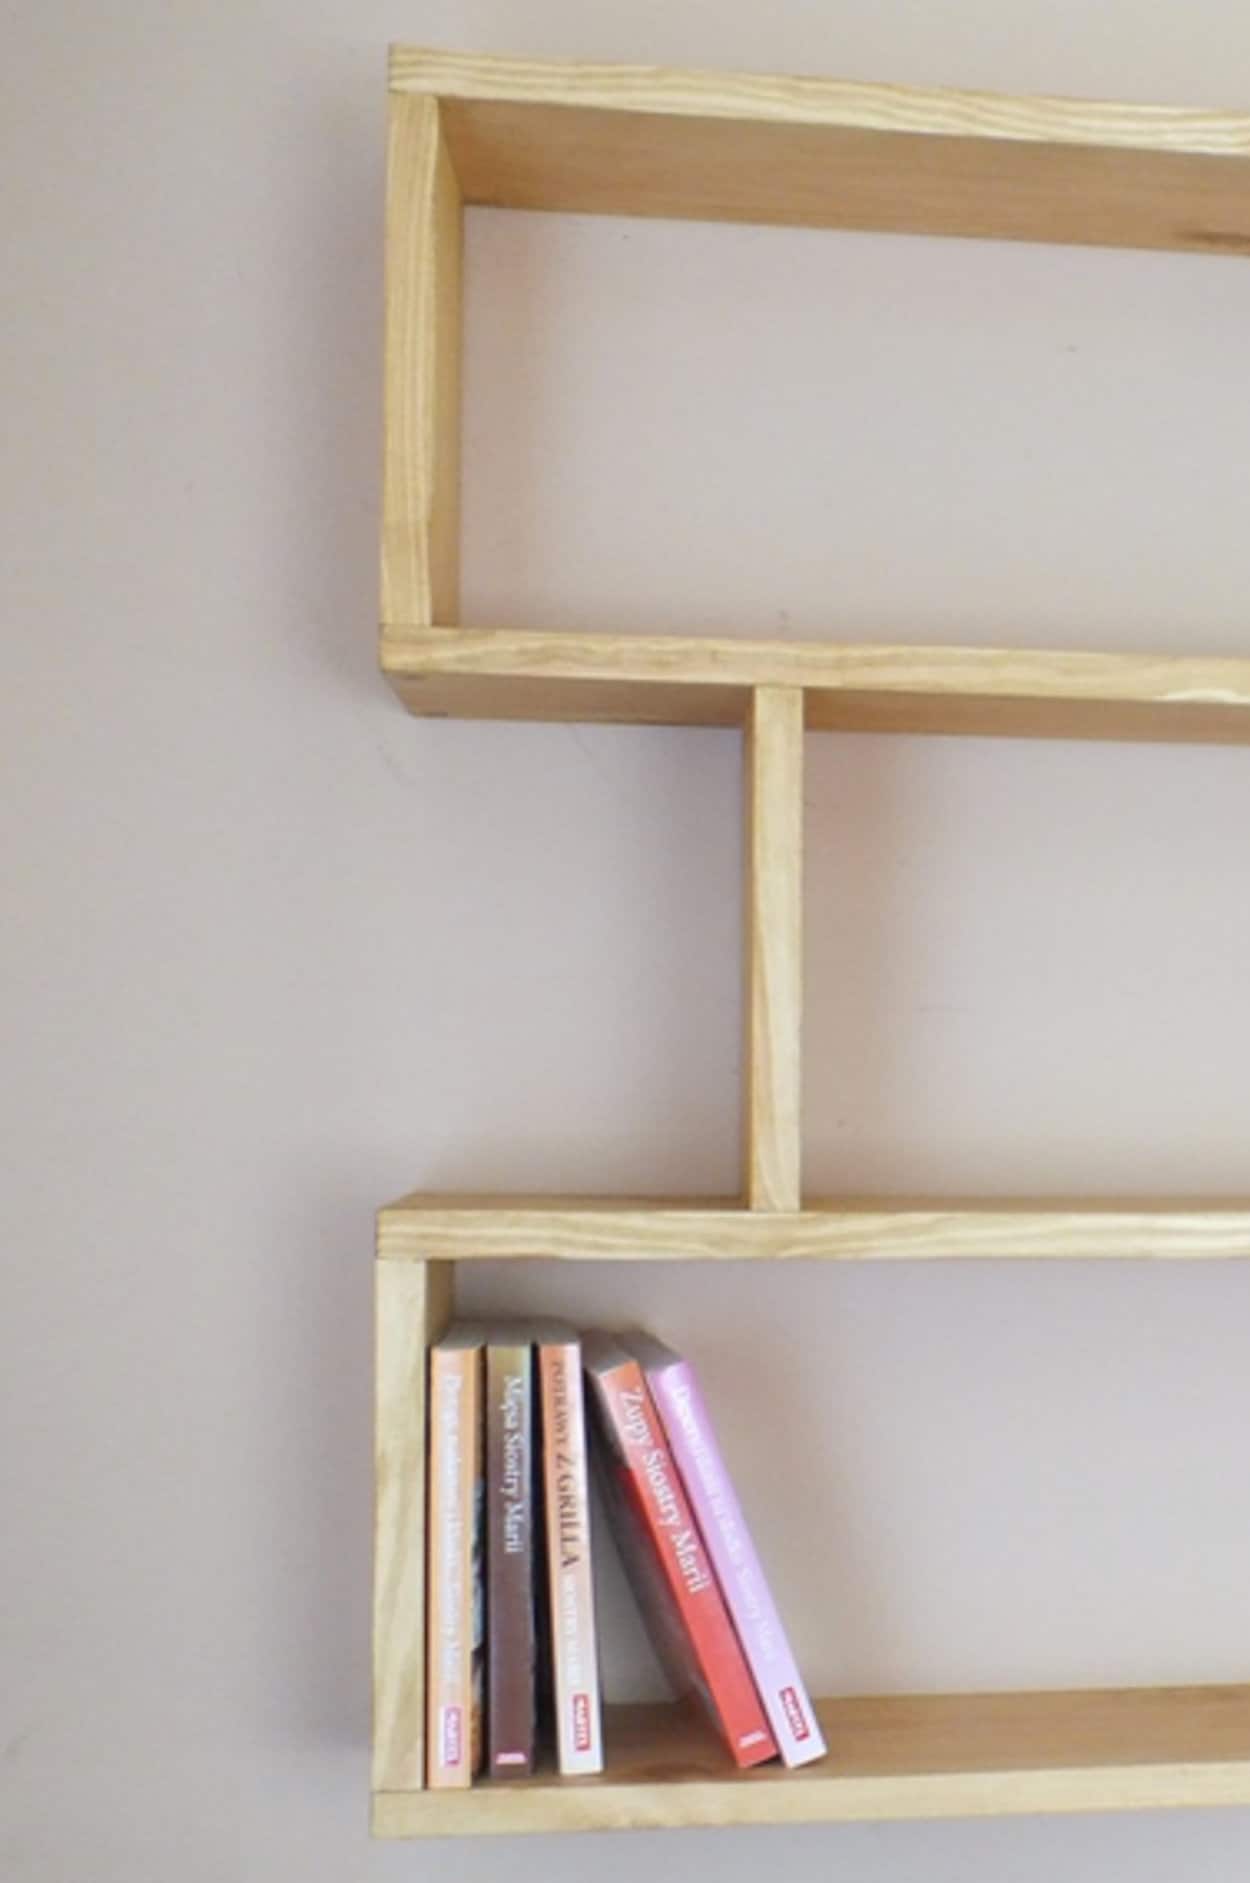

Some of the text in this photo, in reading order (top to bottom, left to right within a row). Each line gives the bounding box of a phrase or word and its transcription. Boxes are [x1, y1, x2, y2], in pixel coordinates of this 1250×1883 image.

[499, 1433, 523, 1496] Siostry
[613, 1385, 710, 1593] Zupy Siostry Marii
[504, 1502, 524, 1553] Marii
[556, 1474, 581, 1568] GRILLA
